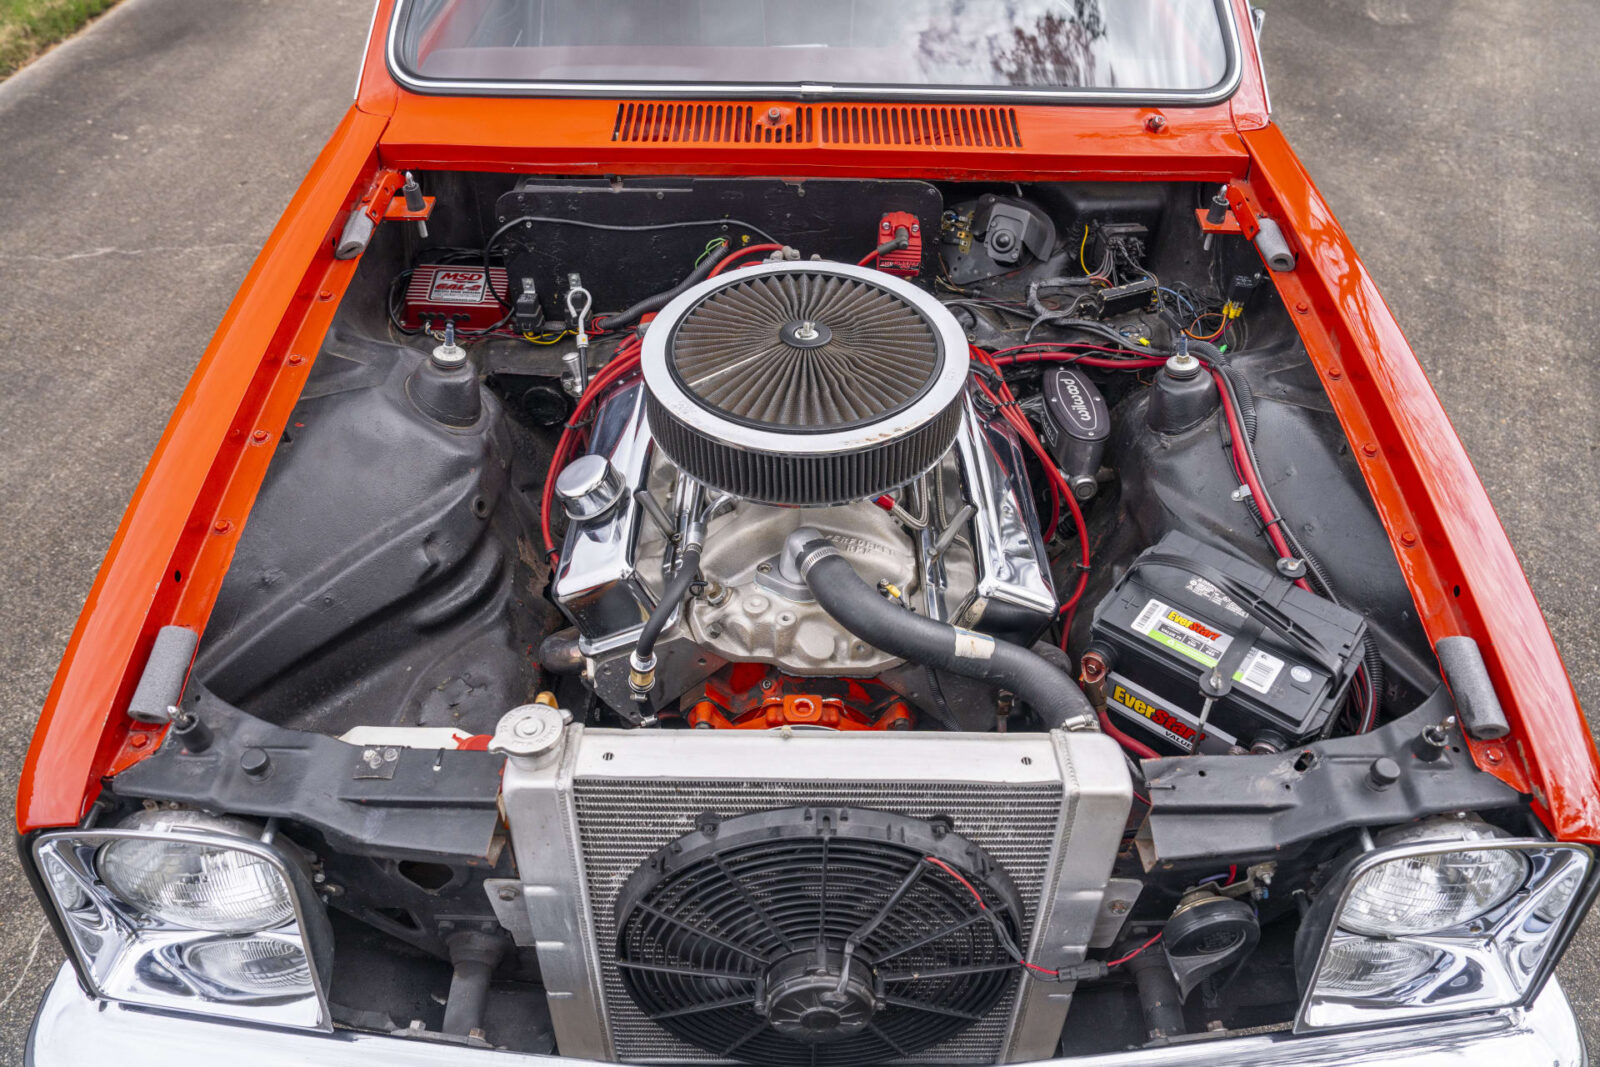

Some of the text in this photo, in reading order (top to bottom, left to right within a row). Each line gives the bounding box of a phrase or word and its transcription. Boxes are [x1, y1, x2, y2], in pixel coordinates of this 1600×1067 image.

[440, 272, 483, 281] MSD
[1060, 378, 1091, 421] wilwood
[1167, 611, 1223, 641] EverStart
[1164, 730, 1194, 751] VALUE
